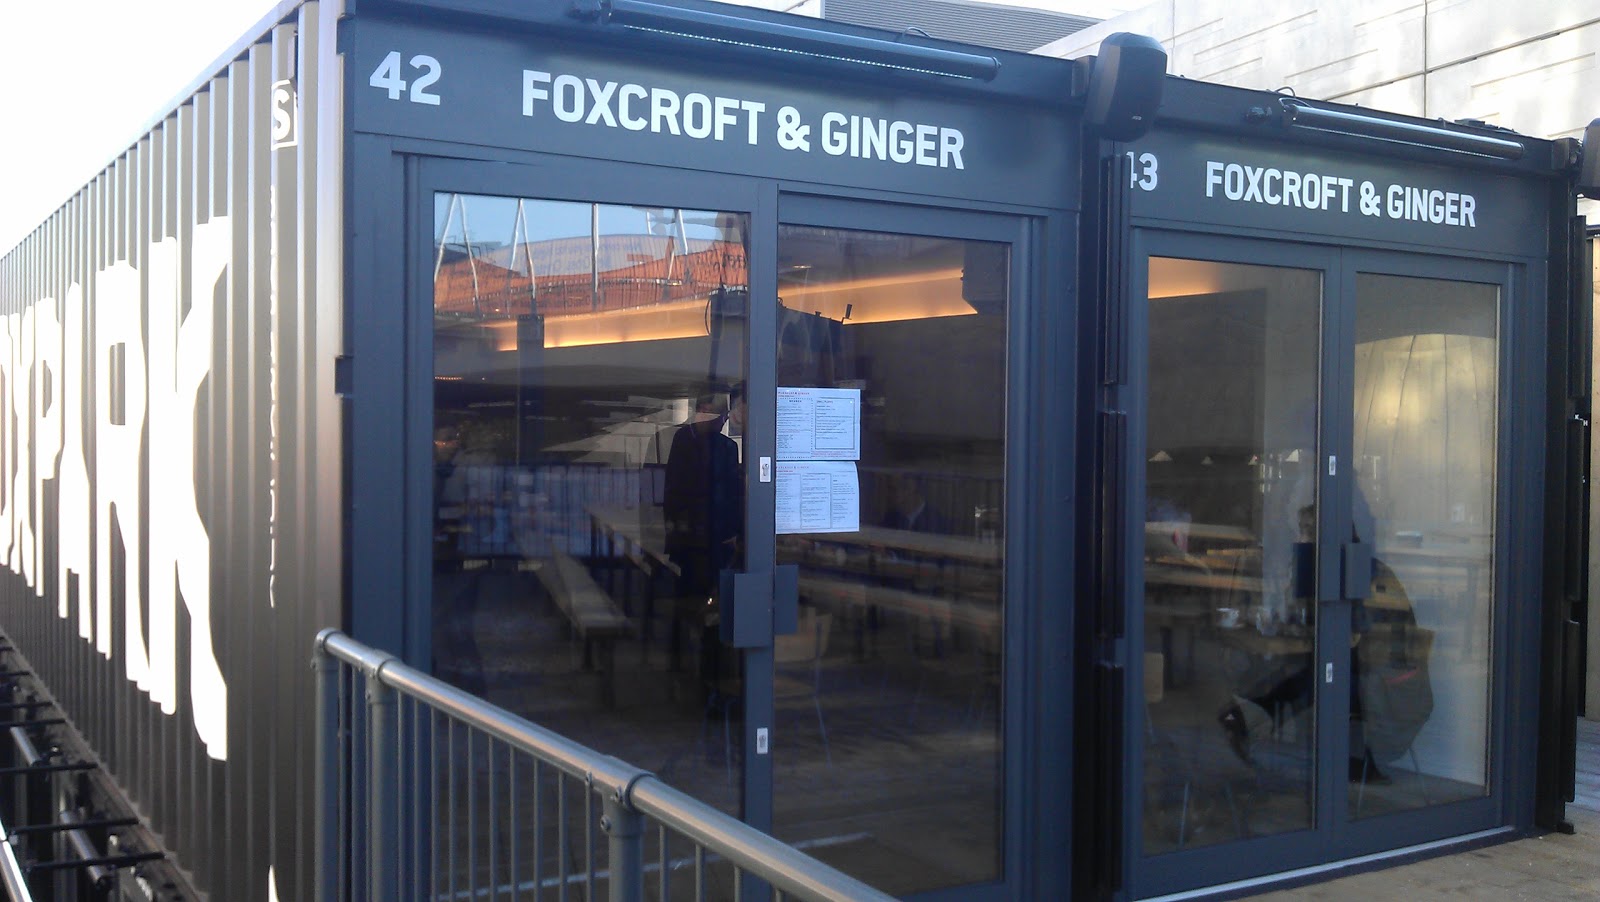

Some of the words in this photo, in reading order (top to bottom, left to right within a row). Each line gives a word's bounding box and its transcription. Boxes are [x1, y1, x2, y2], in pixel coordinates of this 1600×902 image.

[369, 51, 442, 106] 42
[522, 69, 766, 145] FOXCROFT
[776, 105, 811, 153] &
[821, 111, 965, 170] GINGER
[1206, 160, 1354, 213] FOXCROFT
[1359, 180, 1381, 217] &
[1386, 184, 1476, 228] GINGER
